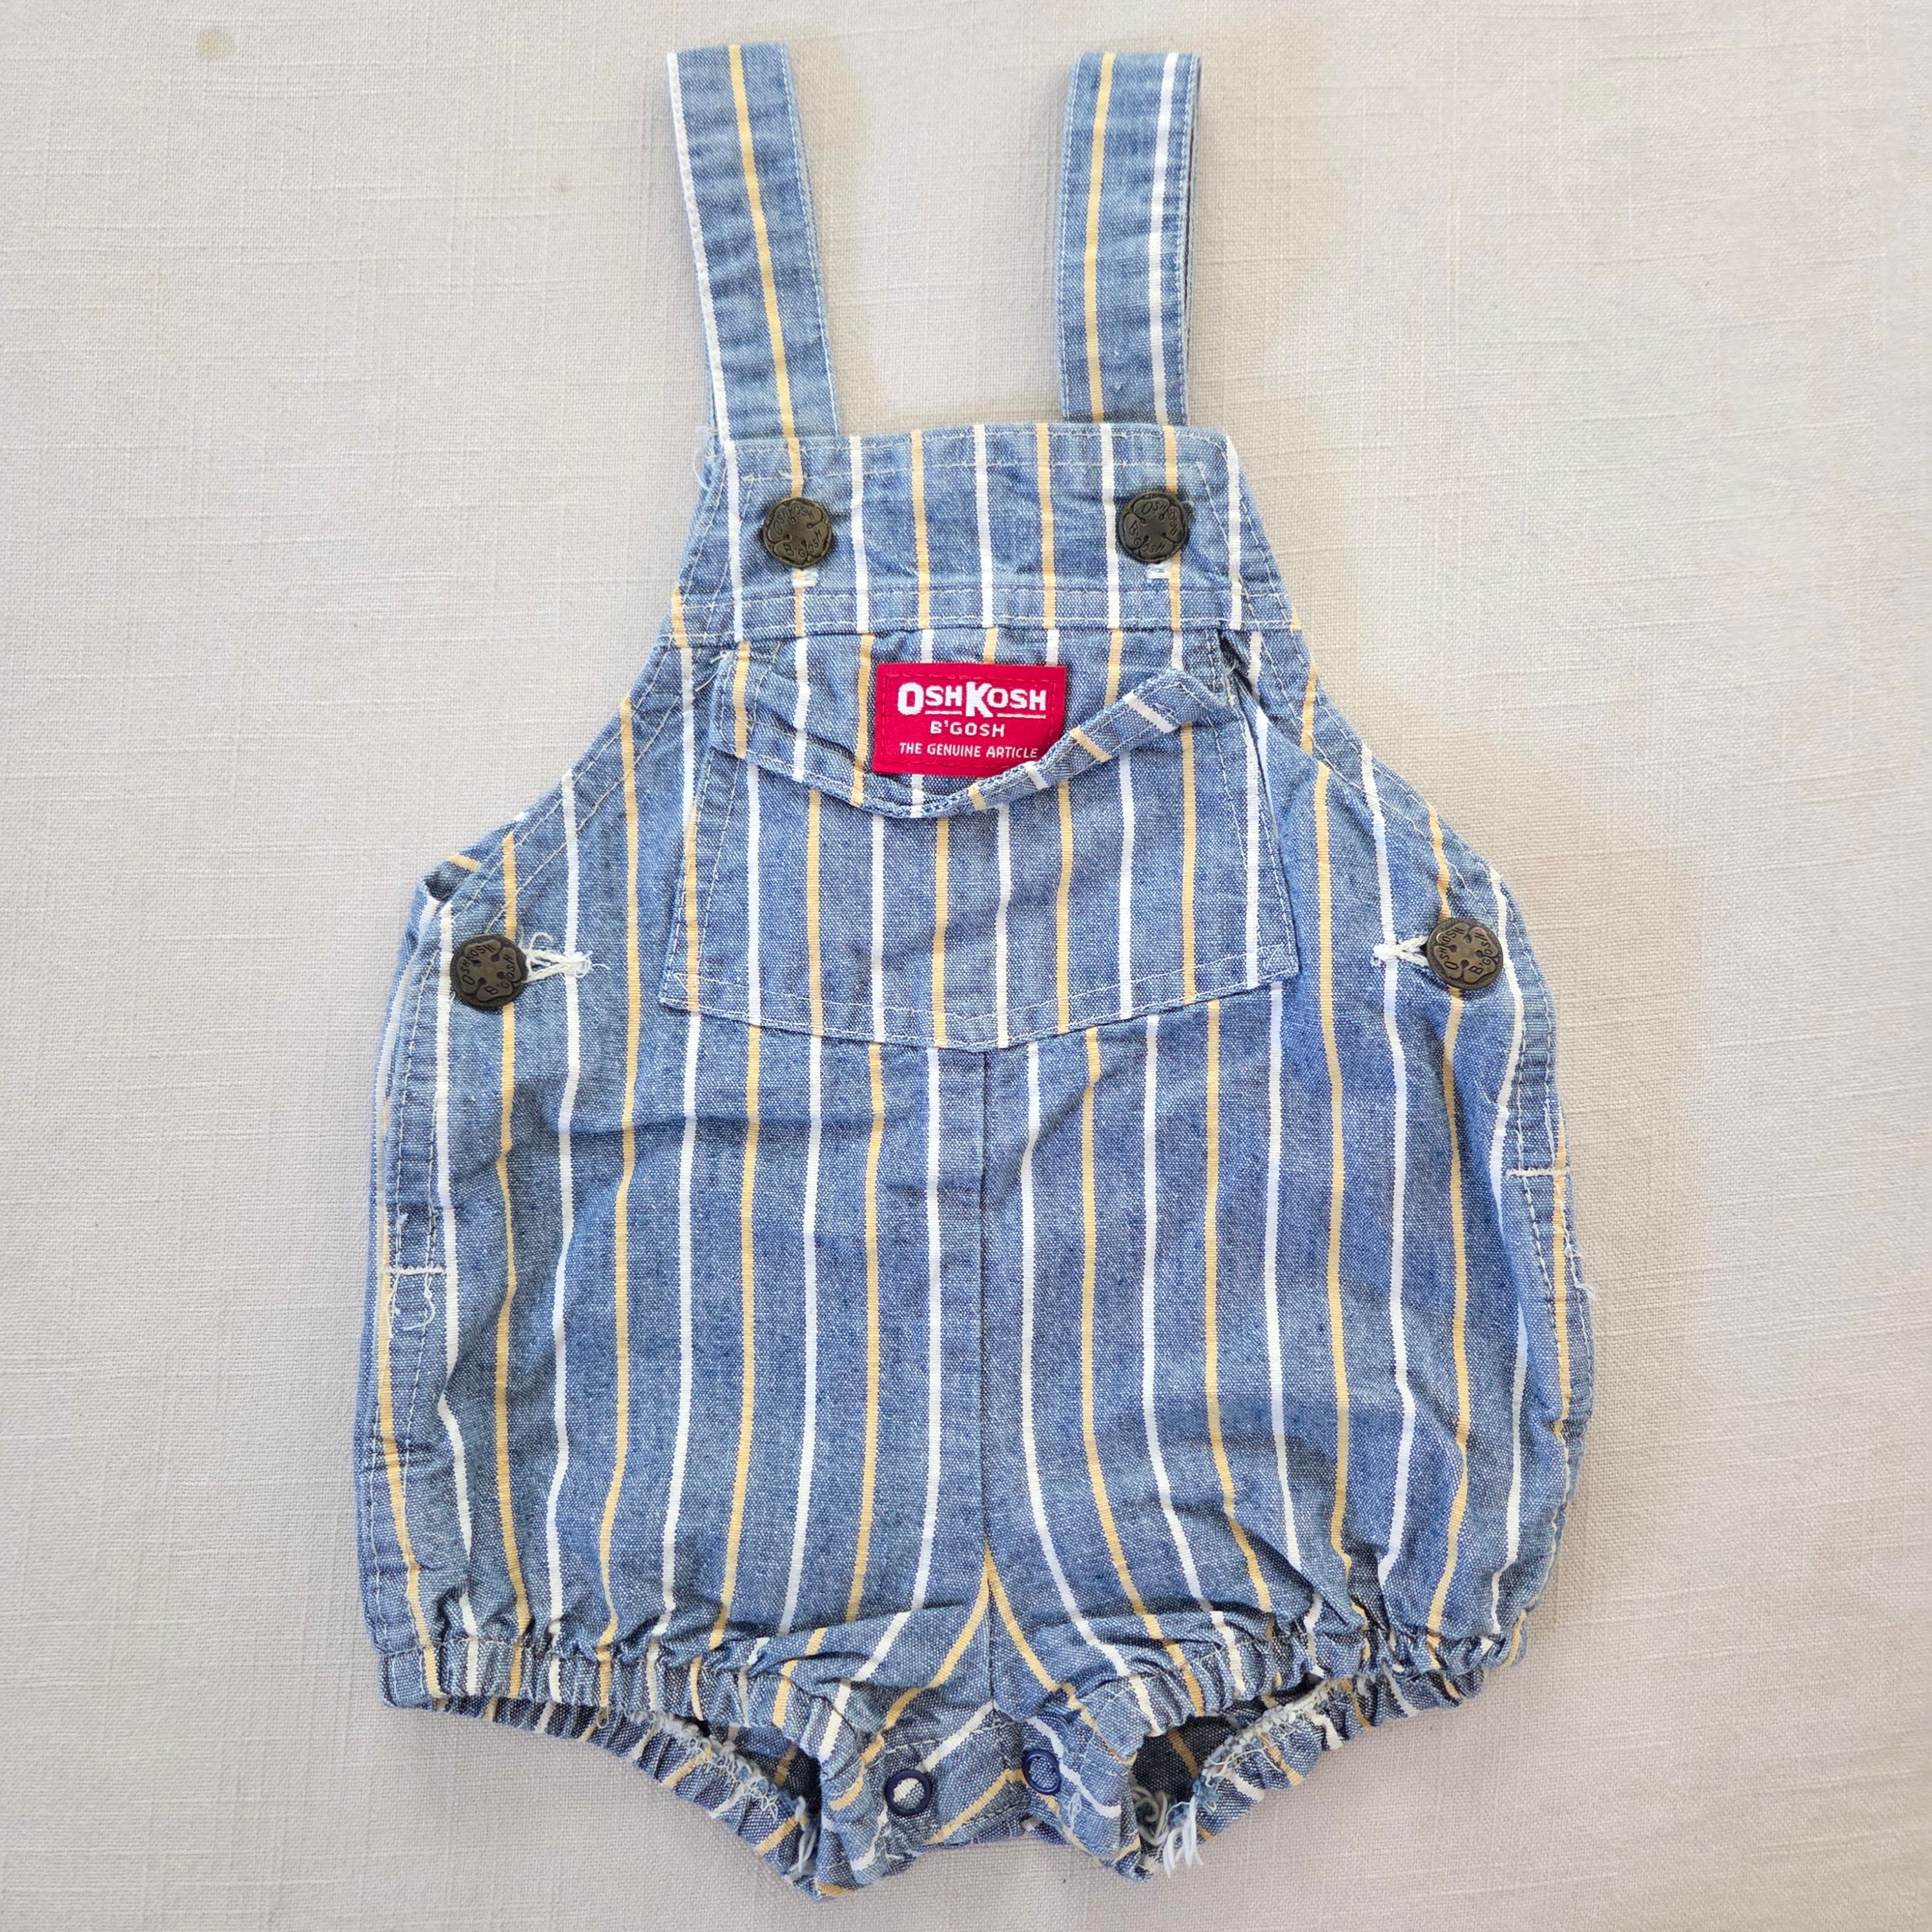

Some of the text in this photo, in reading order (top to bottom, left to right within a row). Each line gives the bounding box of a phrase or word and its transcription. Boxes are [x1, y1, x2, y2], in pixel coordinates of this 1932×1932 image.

[930, 720, 1005, 737] B'GOSH
[899, 743, 1038, 759] THE GENUINE ARTICLE
